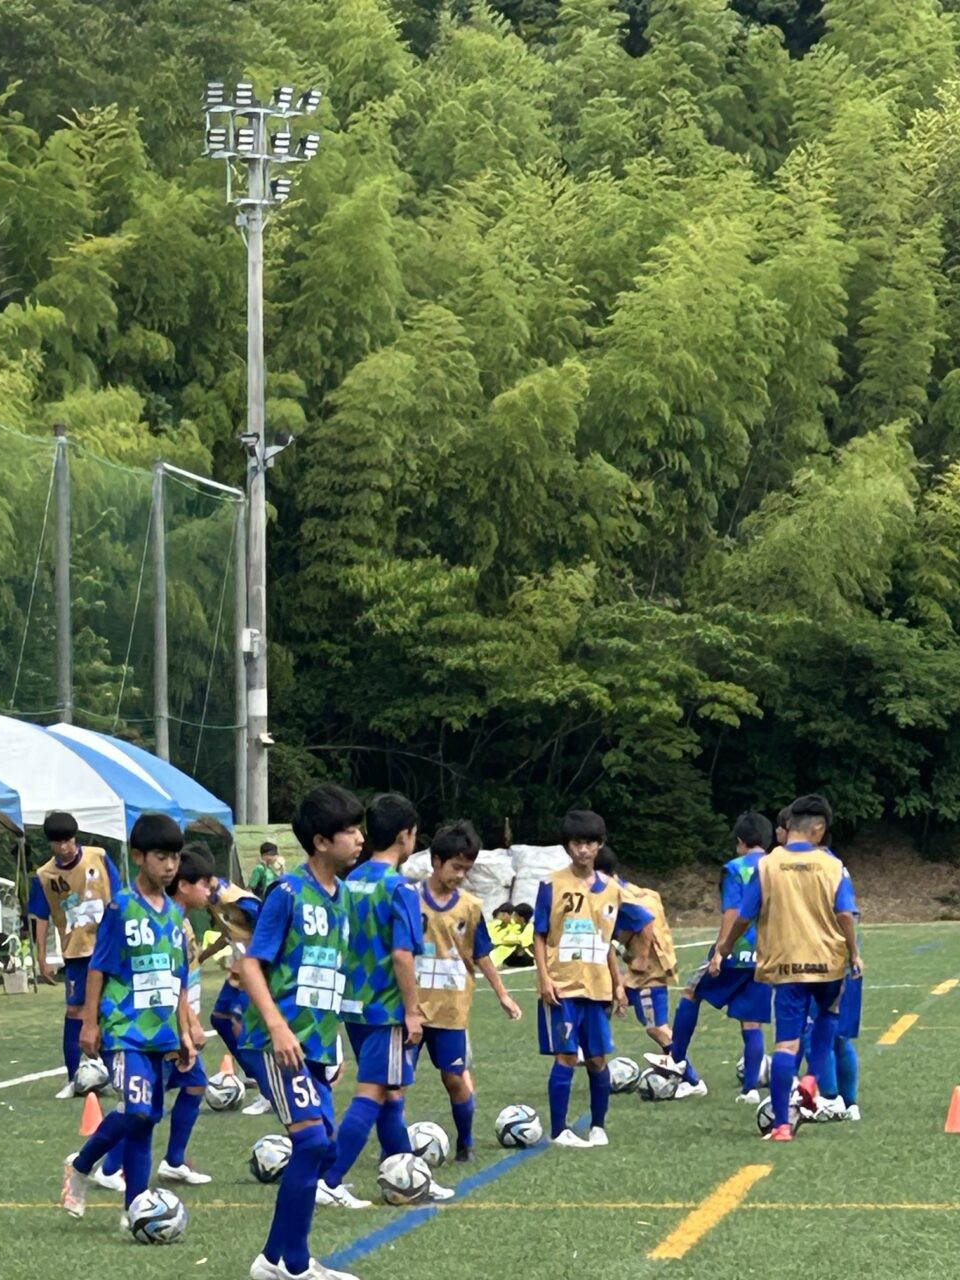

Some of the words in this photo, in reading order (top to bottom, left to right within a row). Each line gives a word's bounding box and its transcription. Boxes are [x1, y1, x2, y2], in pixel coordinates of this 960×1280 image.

[562, 892, 585, 913] 37
[125, 917, 155, 946] 56
[302, 903, 329, 937] 58
